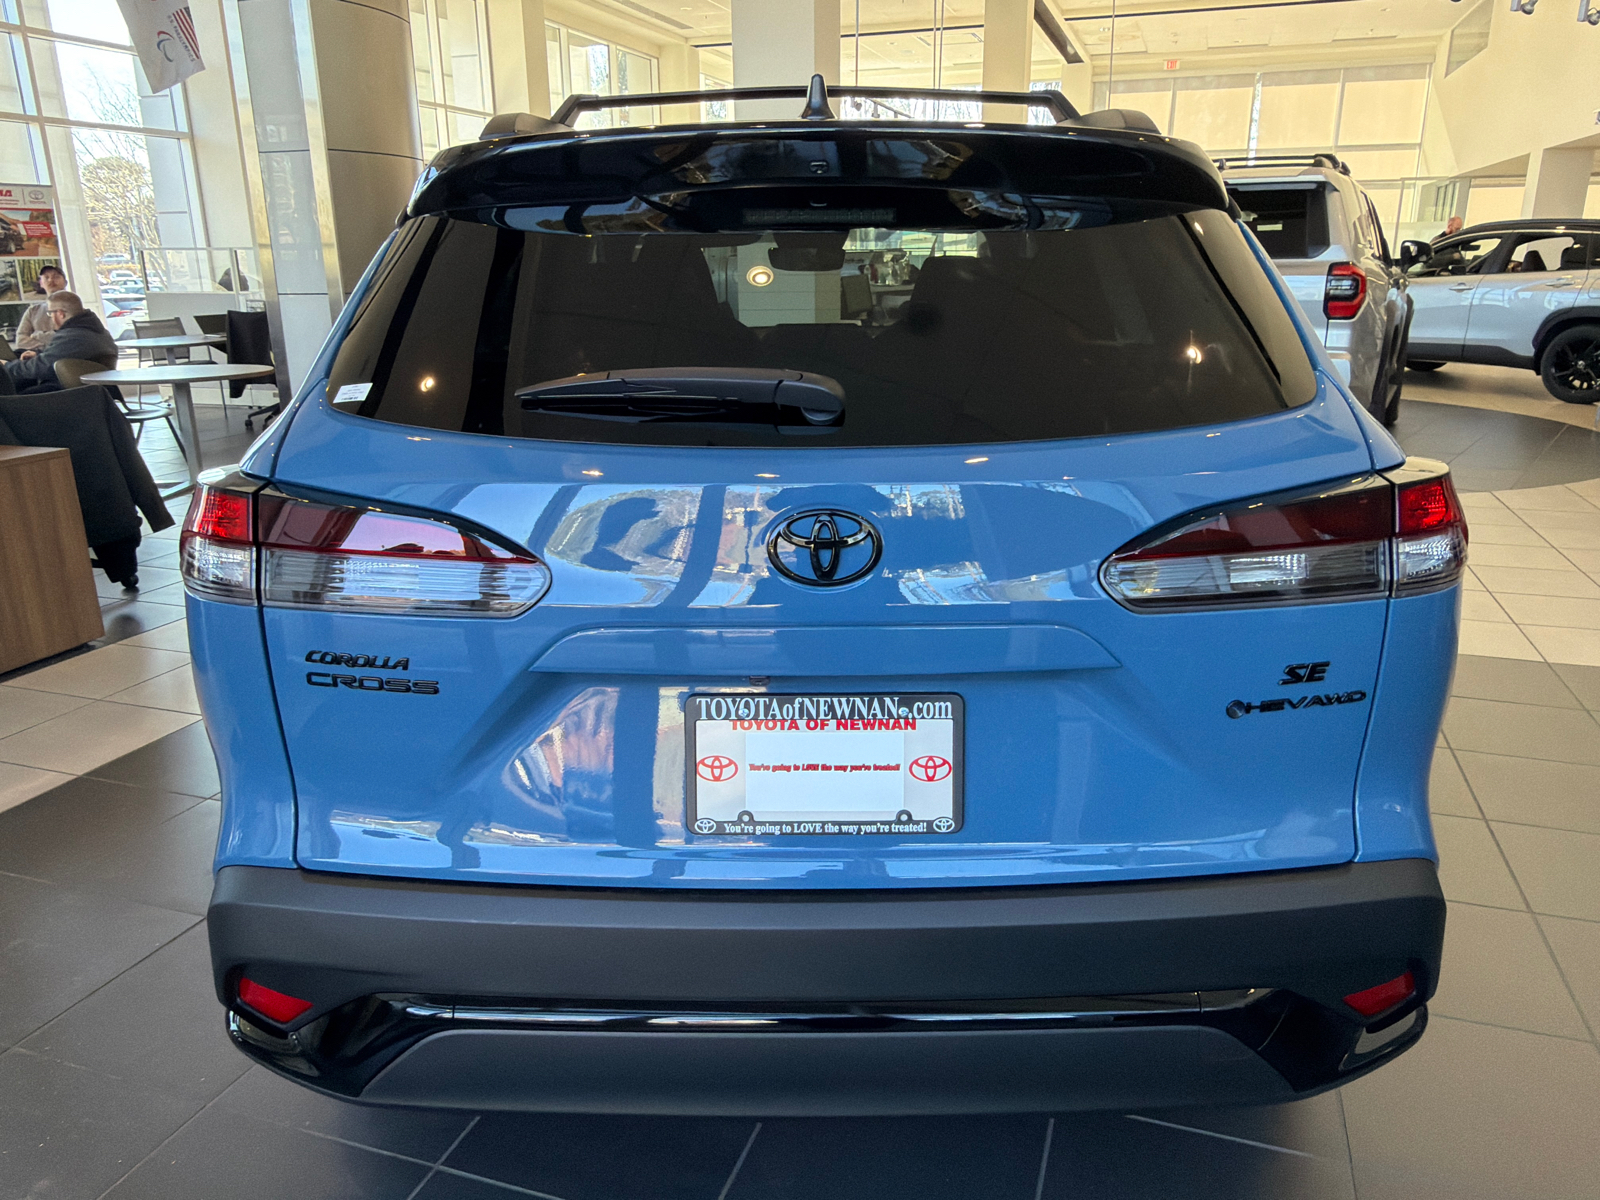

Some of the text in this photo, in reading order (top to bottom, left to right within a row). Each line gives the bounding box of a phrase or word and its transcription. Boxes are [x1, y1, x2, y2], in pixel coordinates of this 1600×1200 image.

[305, 650, 410, 671] COROLLA
[1277, 660, 1331, 685] SE
[306, 671, 440, 695] CROSS
[729, 719, 917, 731] TOYOTA OF NEWNAN
[793, 764, 801, 772] to
[833, 764, 848, 773] way
[724, 822, 928, 836] You're going to LOVE the way you're treated!
